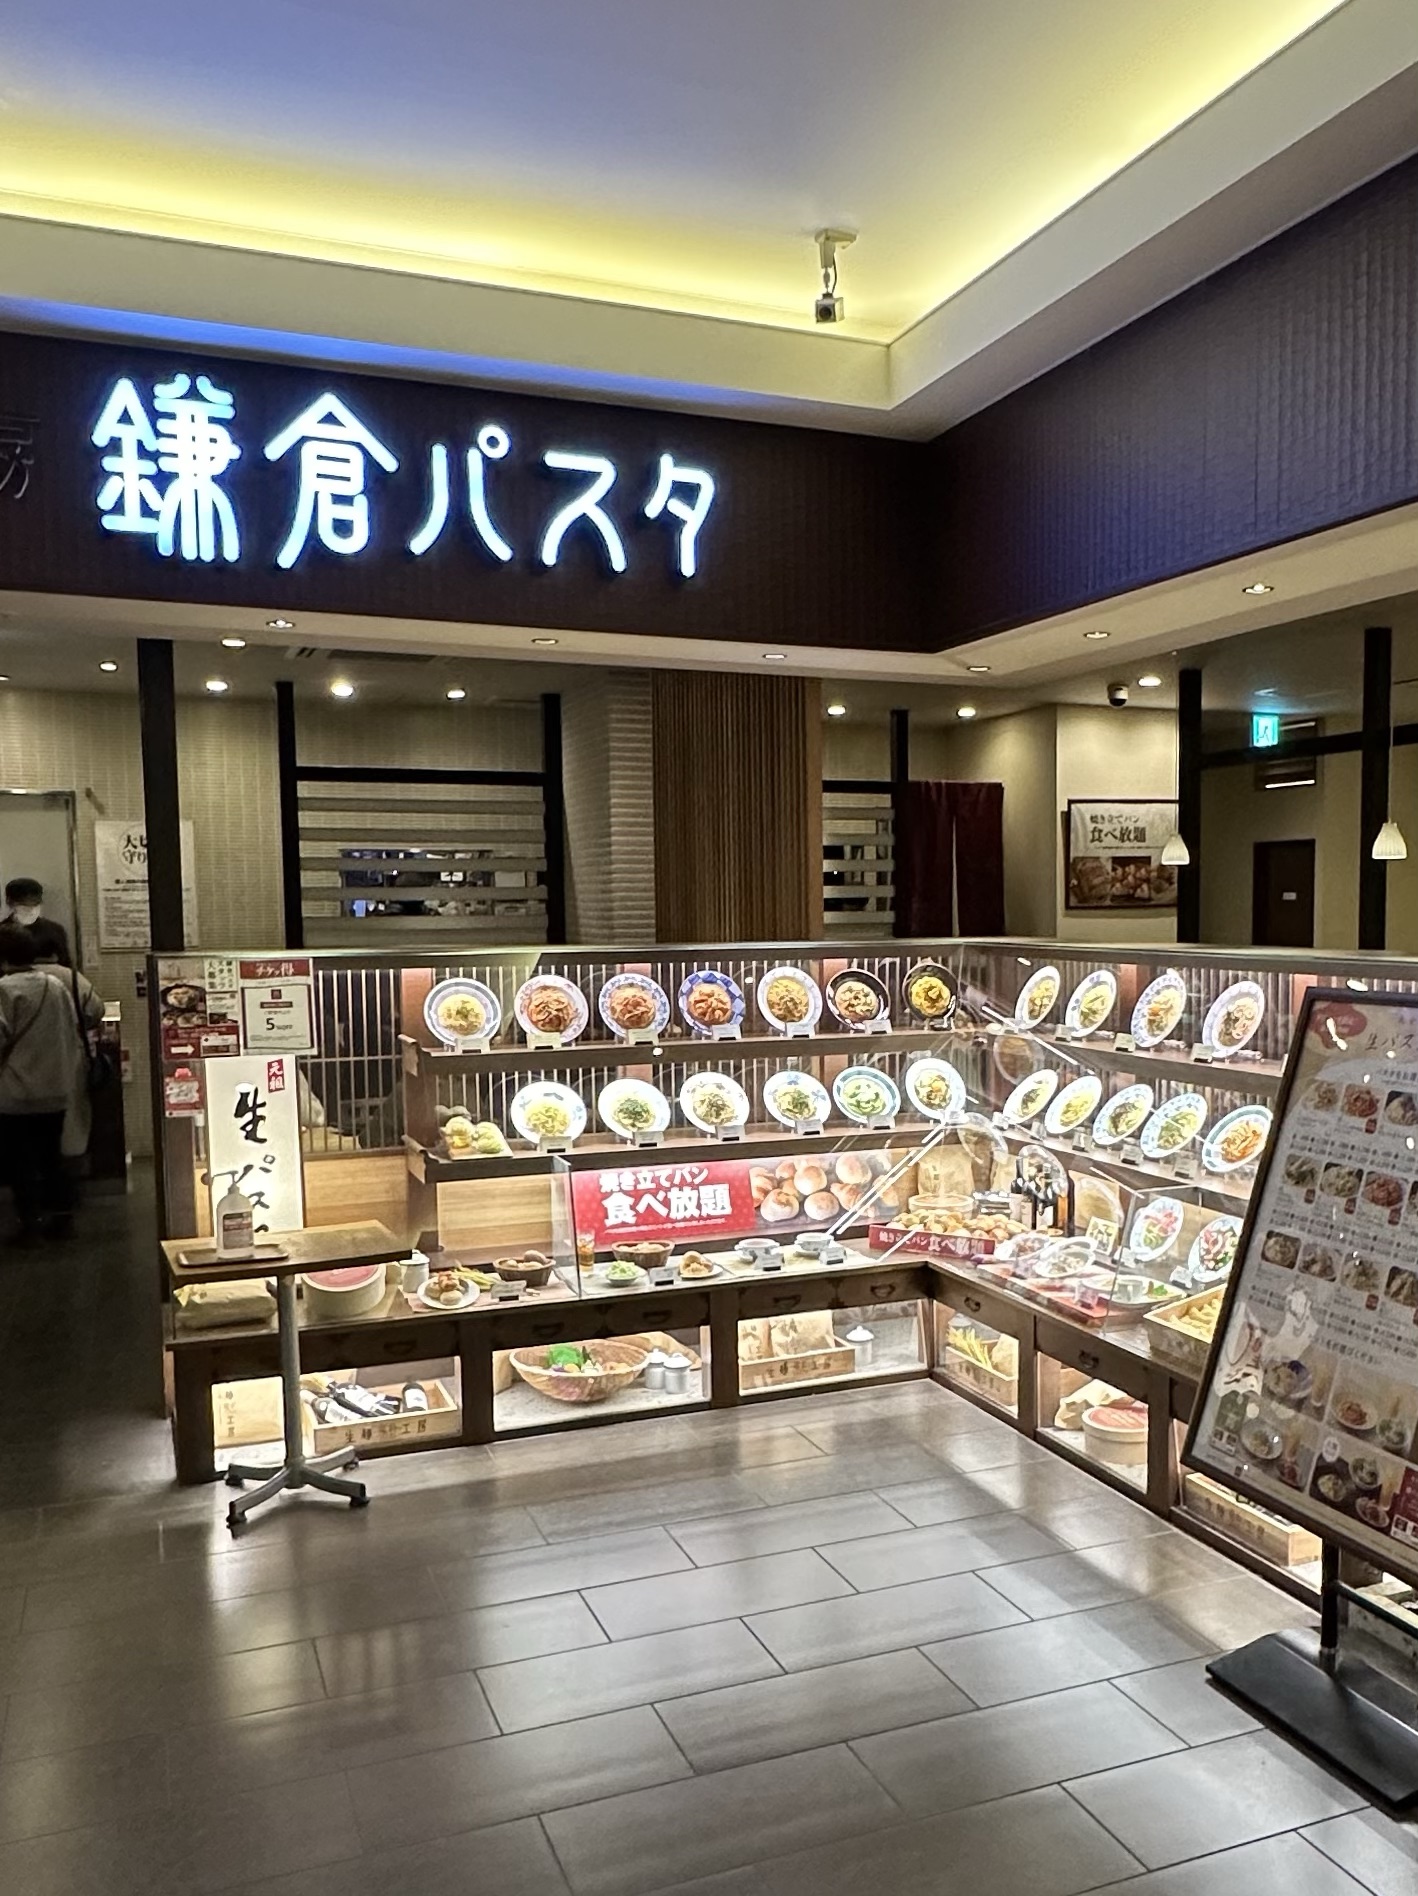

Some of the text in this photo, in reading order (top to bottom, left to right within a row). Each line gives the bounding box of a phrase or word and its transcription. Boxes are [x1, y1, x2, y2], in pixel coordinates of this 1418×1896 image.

[92, 373, 716, 577] 鎌倉パスタ
[1089, 826, 1146, 843] 食べ放題
[268, 1061, 285, 1091] 元祖
[233, 1086, 276, 1233] 生パス
[600, 1167, 708, 1193] 焼き立てパン
[602, 1183, 733, 1227] 食べ放題
